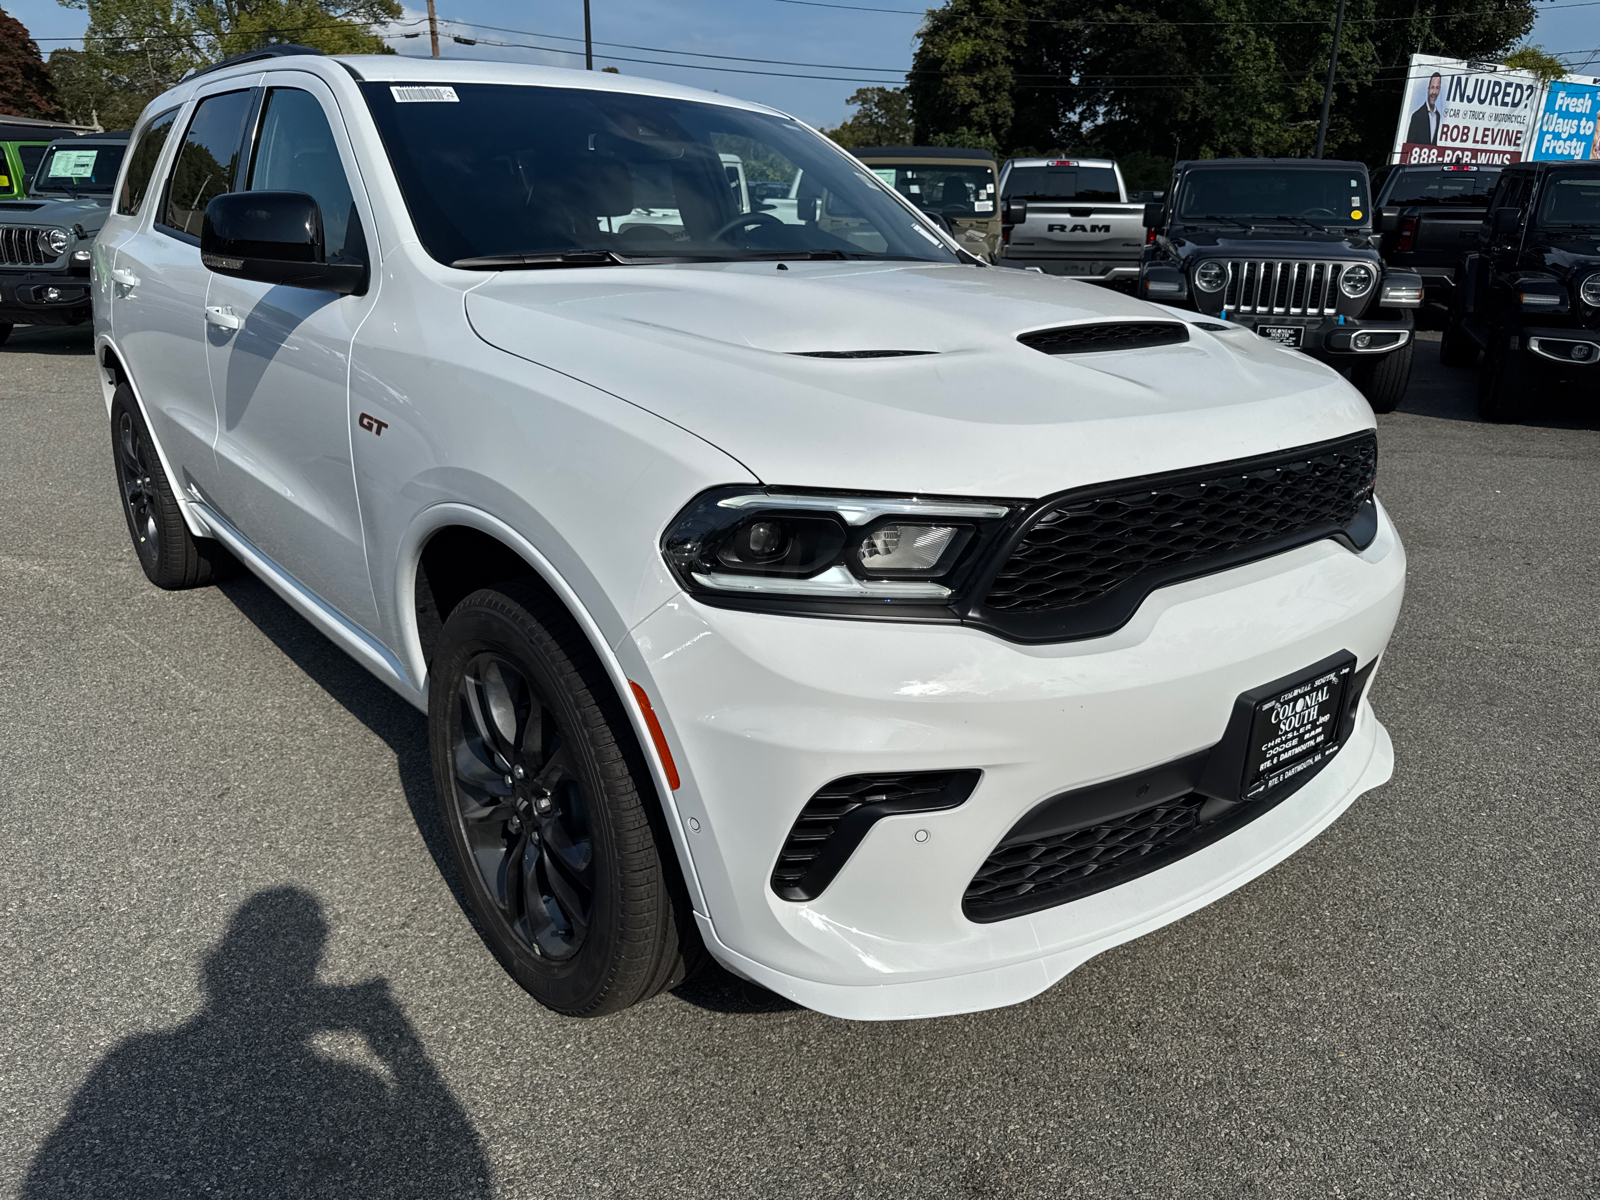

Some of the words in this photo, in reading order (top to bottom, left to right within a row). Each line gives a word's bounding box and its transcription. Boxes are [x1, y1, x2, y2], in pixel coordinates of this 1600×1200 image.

[1446, 75, 1534, 109] INJURED?
[1555, 91, 1592, 114] Fresh
[1449, 108, 1461, 118] CAR
[1468, 110, 1486, 121] TRUCK
[1493, 113, 1526, 124] MOTORCYCLE
[1542, 112, 1578, 139] Ways
[1579, 117, 1594, 135] to
[1439, 124, 1470, 143] ROB
[1472, 127, 1523, 147] LEVINE
[1542, 134, 1587, 160] Frosty
[1047, 224, 1111, 233] RAM
[359, 412, 389, 437] GT
[1271, 685, 1330, 724] COLONIAL
[1278, 705, 1319, 735] SOUTH
[1316, 713, 1331, 726] Jeep
[1261, 724, 1312, 751] CHRYSLER
[1266, 737, 1299, 758] DODGE
[1303, 726, 1323, 740] RAM
[1259, 759, 1272, 772] RTE.
[1272, 756, 1278, 764] 6
[1315, 734, 1325, 743] MA
[1314, 753, 1322, 763] MA
